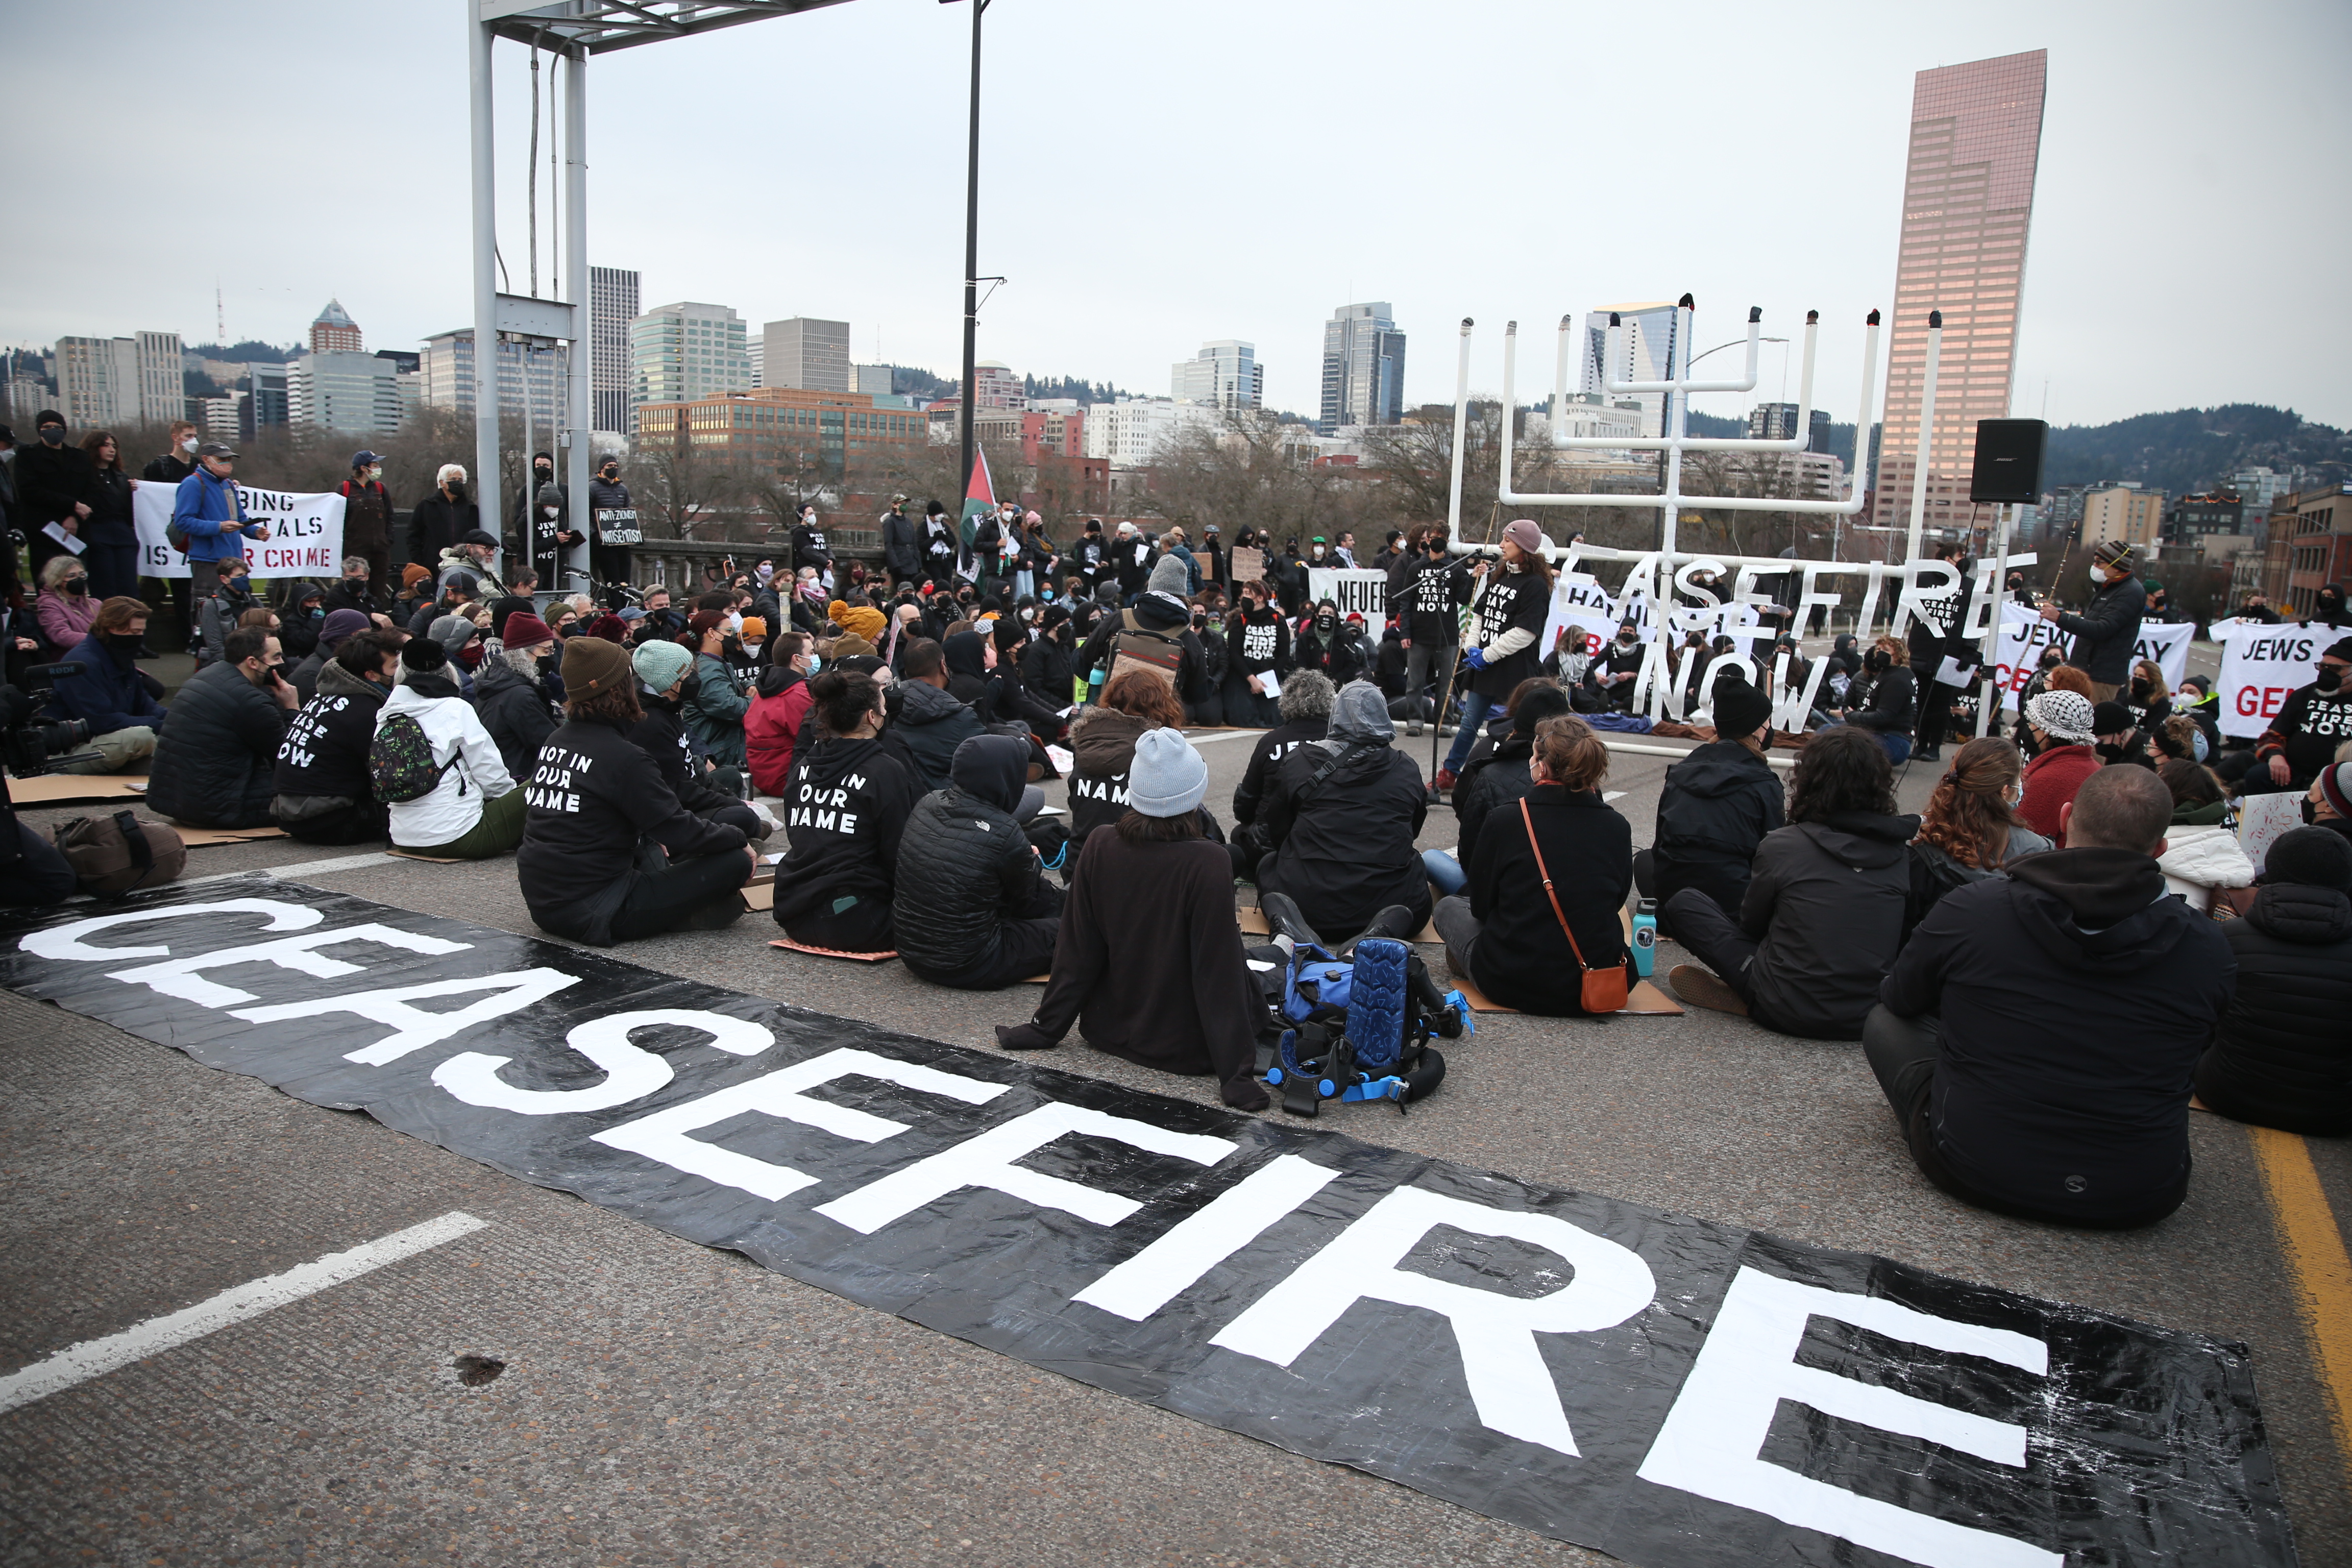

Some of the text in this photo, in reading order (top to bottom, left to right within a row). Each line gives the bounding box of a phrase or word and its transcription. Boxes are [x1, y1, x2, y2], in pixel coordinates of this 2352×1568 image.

[238, 491, 294, 511] BING
[249, 517, 322, 536] TALS
[537, 521, 556, 530] JEW
[542, 529, 557, 538] SA
[146, 545, 168, 566] IS
[265, 548, 330, 567] CRIME
[537, 551, 556, 559] NO
[1418, 586, 1450, 595] CEAE
[1489, 583, 1517, 600] EWS
[1417, 602, 1450, 612] NOW
[1486, 594, 1507, 609] SAY
[1924, 600, 1959, 612] CEASE
[1484, 607, 1507, 623] EASE
[1927, 608, 1952, 619] FIRE
[1245, 624, 1277, 636] CEASE
[1484, 618, 1501, 631] IRE
[1243, 634, 1277, 650] FIRE
[1481, 629, 1499, 644] OW
[2012, 623, 2171, 663] JEW AY
[2242, 639, 2314, 662] JEWS
[1633, 642, 1829, 734] NOW
[292, 713, 328, 739] EASE
[2309, 712, 2352, 725] FIRE
[286, 727, 310, 746] IRE
[277, 742, 315, 768] OW
[538, 746, 593, 773] NOT IN
[535, 765, 572, 789] OUR
[524, 787, 580, 813] NAME
[799, 783, 848, 808] OUR
[1077, 778, 1130, 806] NAM
[790, 807, 857, 834] NAME
[18, 898, 2064, 1568] CEASEFIRE
